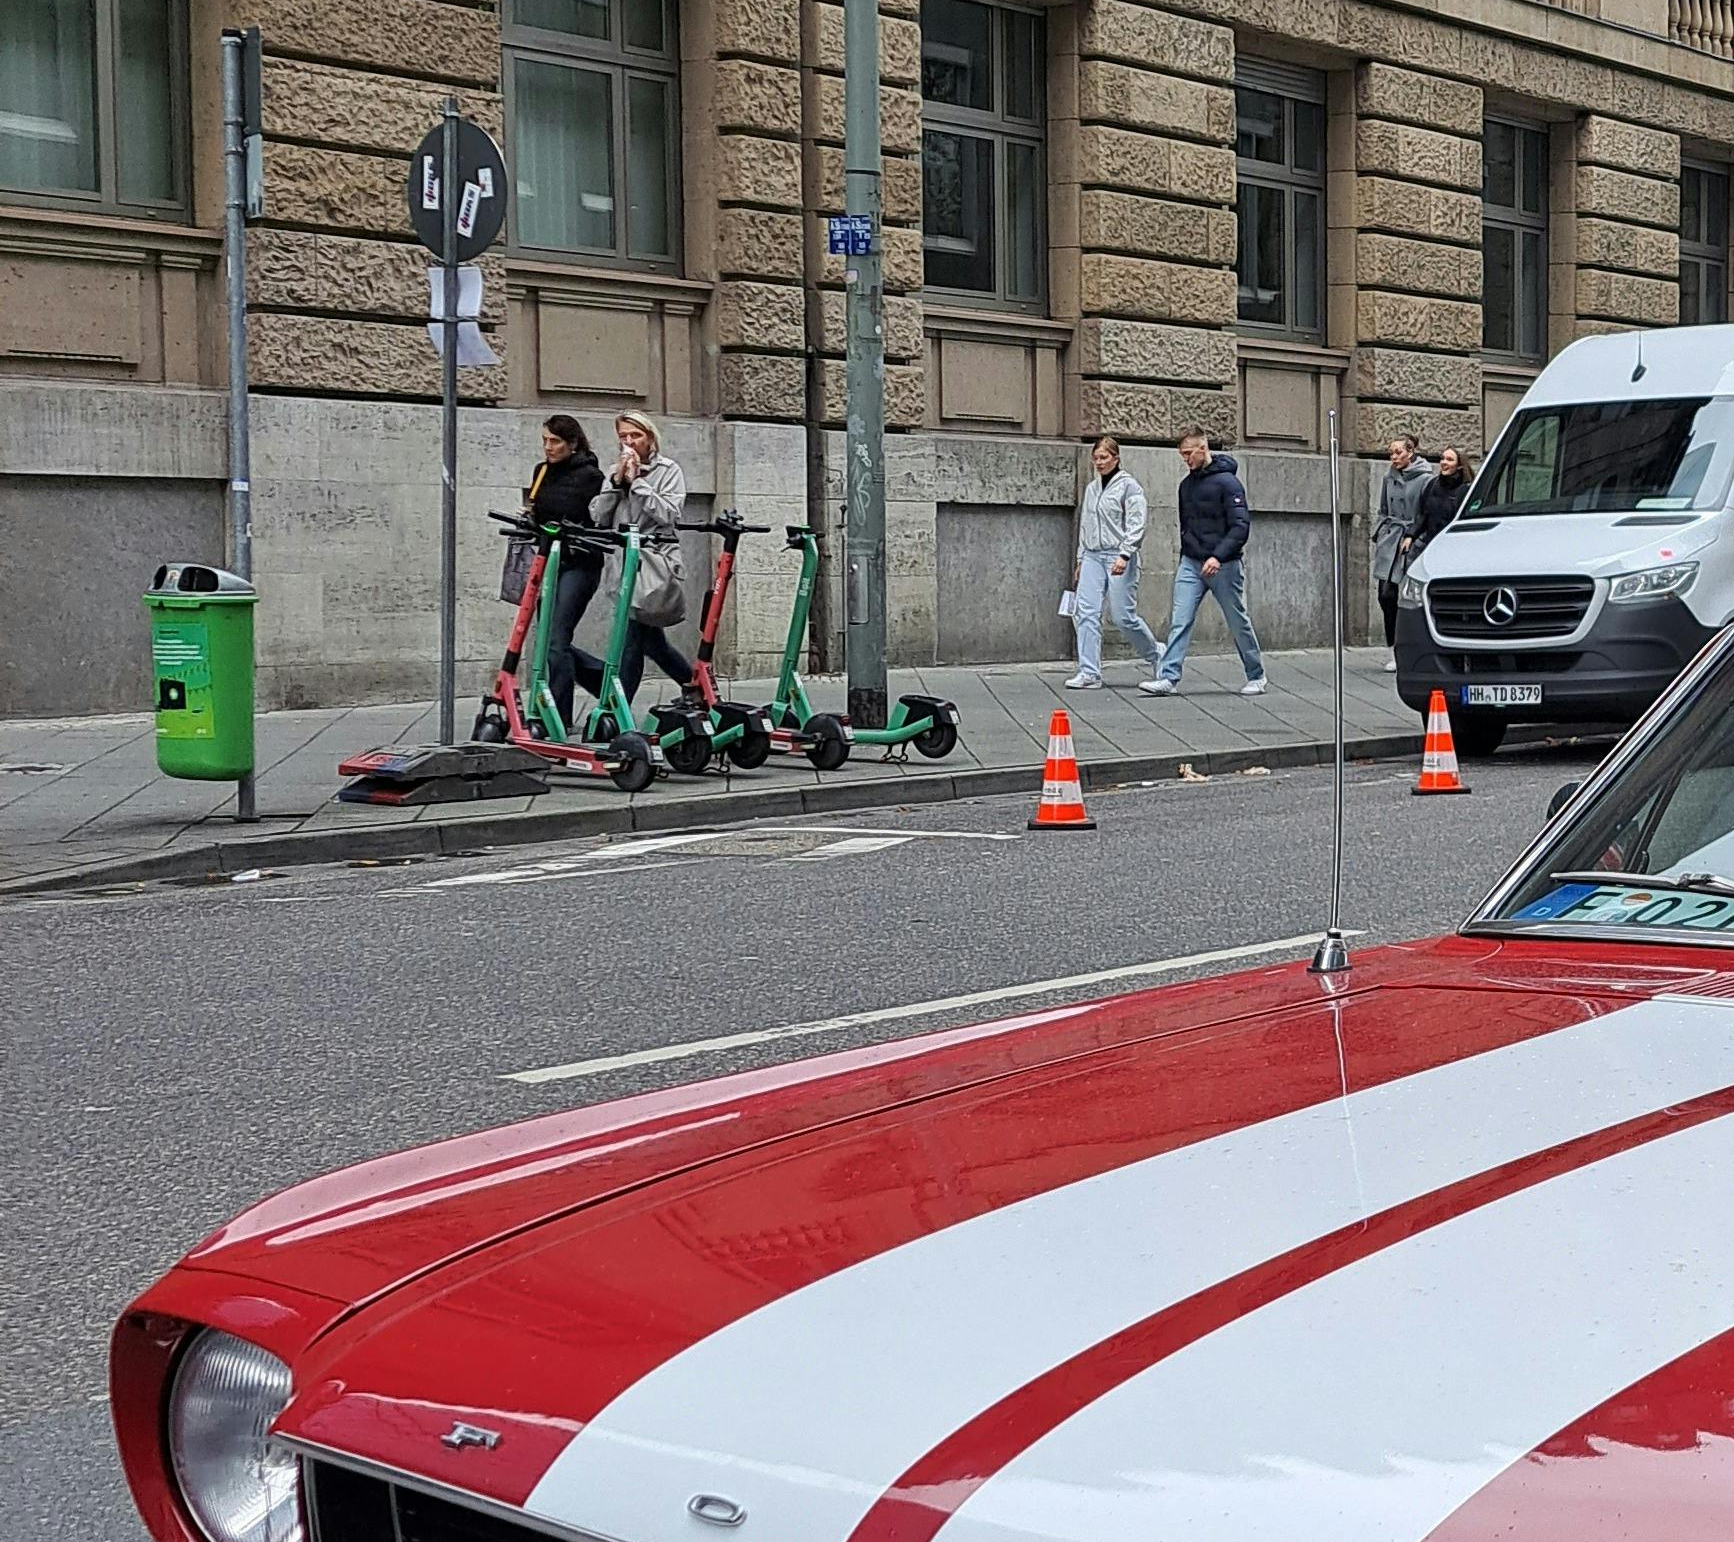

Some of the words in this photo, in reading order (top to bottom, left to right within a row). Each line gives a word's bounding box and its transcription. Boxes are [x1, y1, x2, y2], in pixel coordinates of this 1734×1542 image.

[1469, 687, 1484, 701] HH
[1492, 687, 1507, 701] TD
[1510, 687, 1540, 701] 8379
